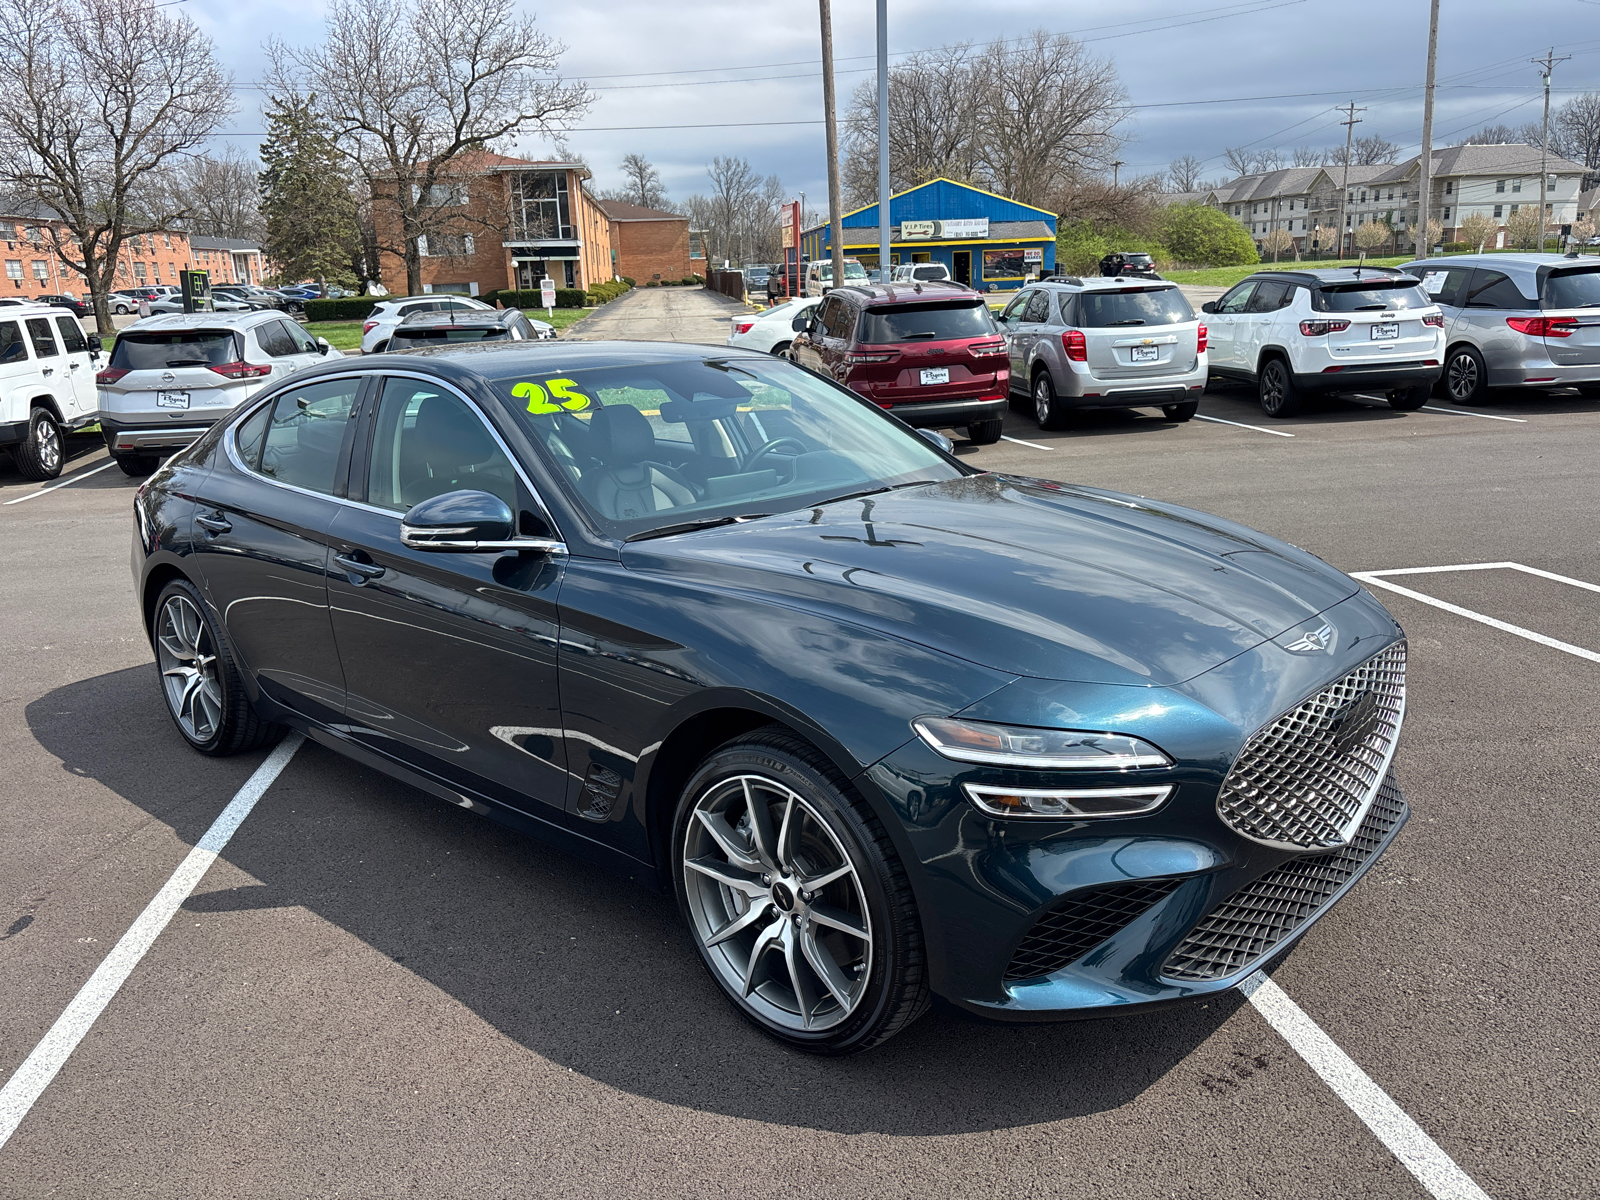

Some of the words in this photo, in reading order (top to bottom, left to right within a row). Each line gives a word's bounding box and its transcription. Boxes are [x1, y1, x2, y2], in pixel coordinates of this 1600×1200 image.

[511, 378, 591, 415] 25
[789, 768, 813, 787] PRIMACY
[812, 785, 827, 801] TOUR
